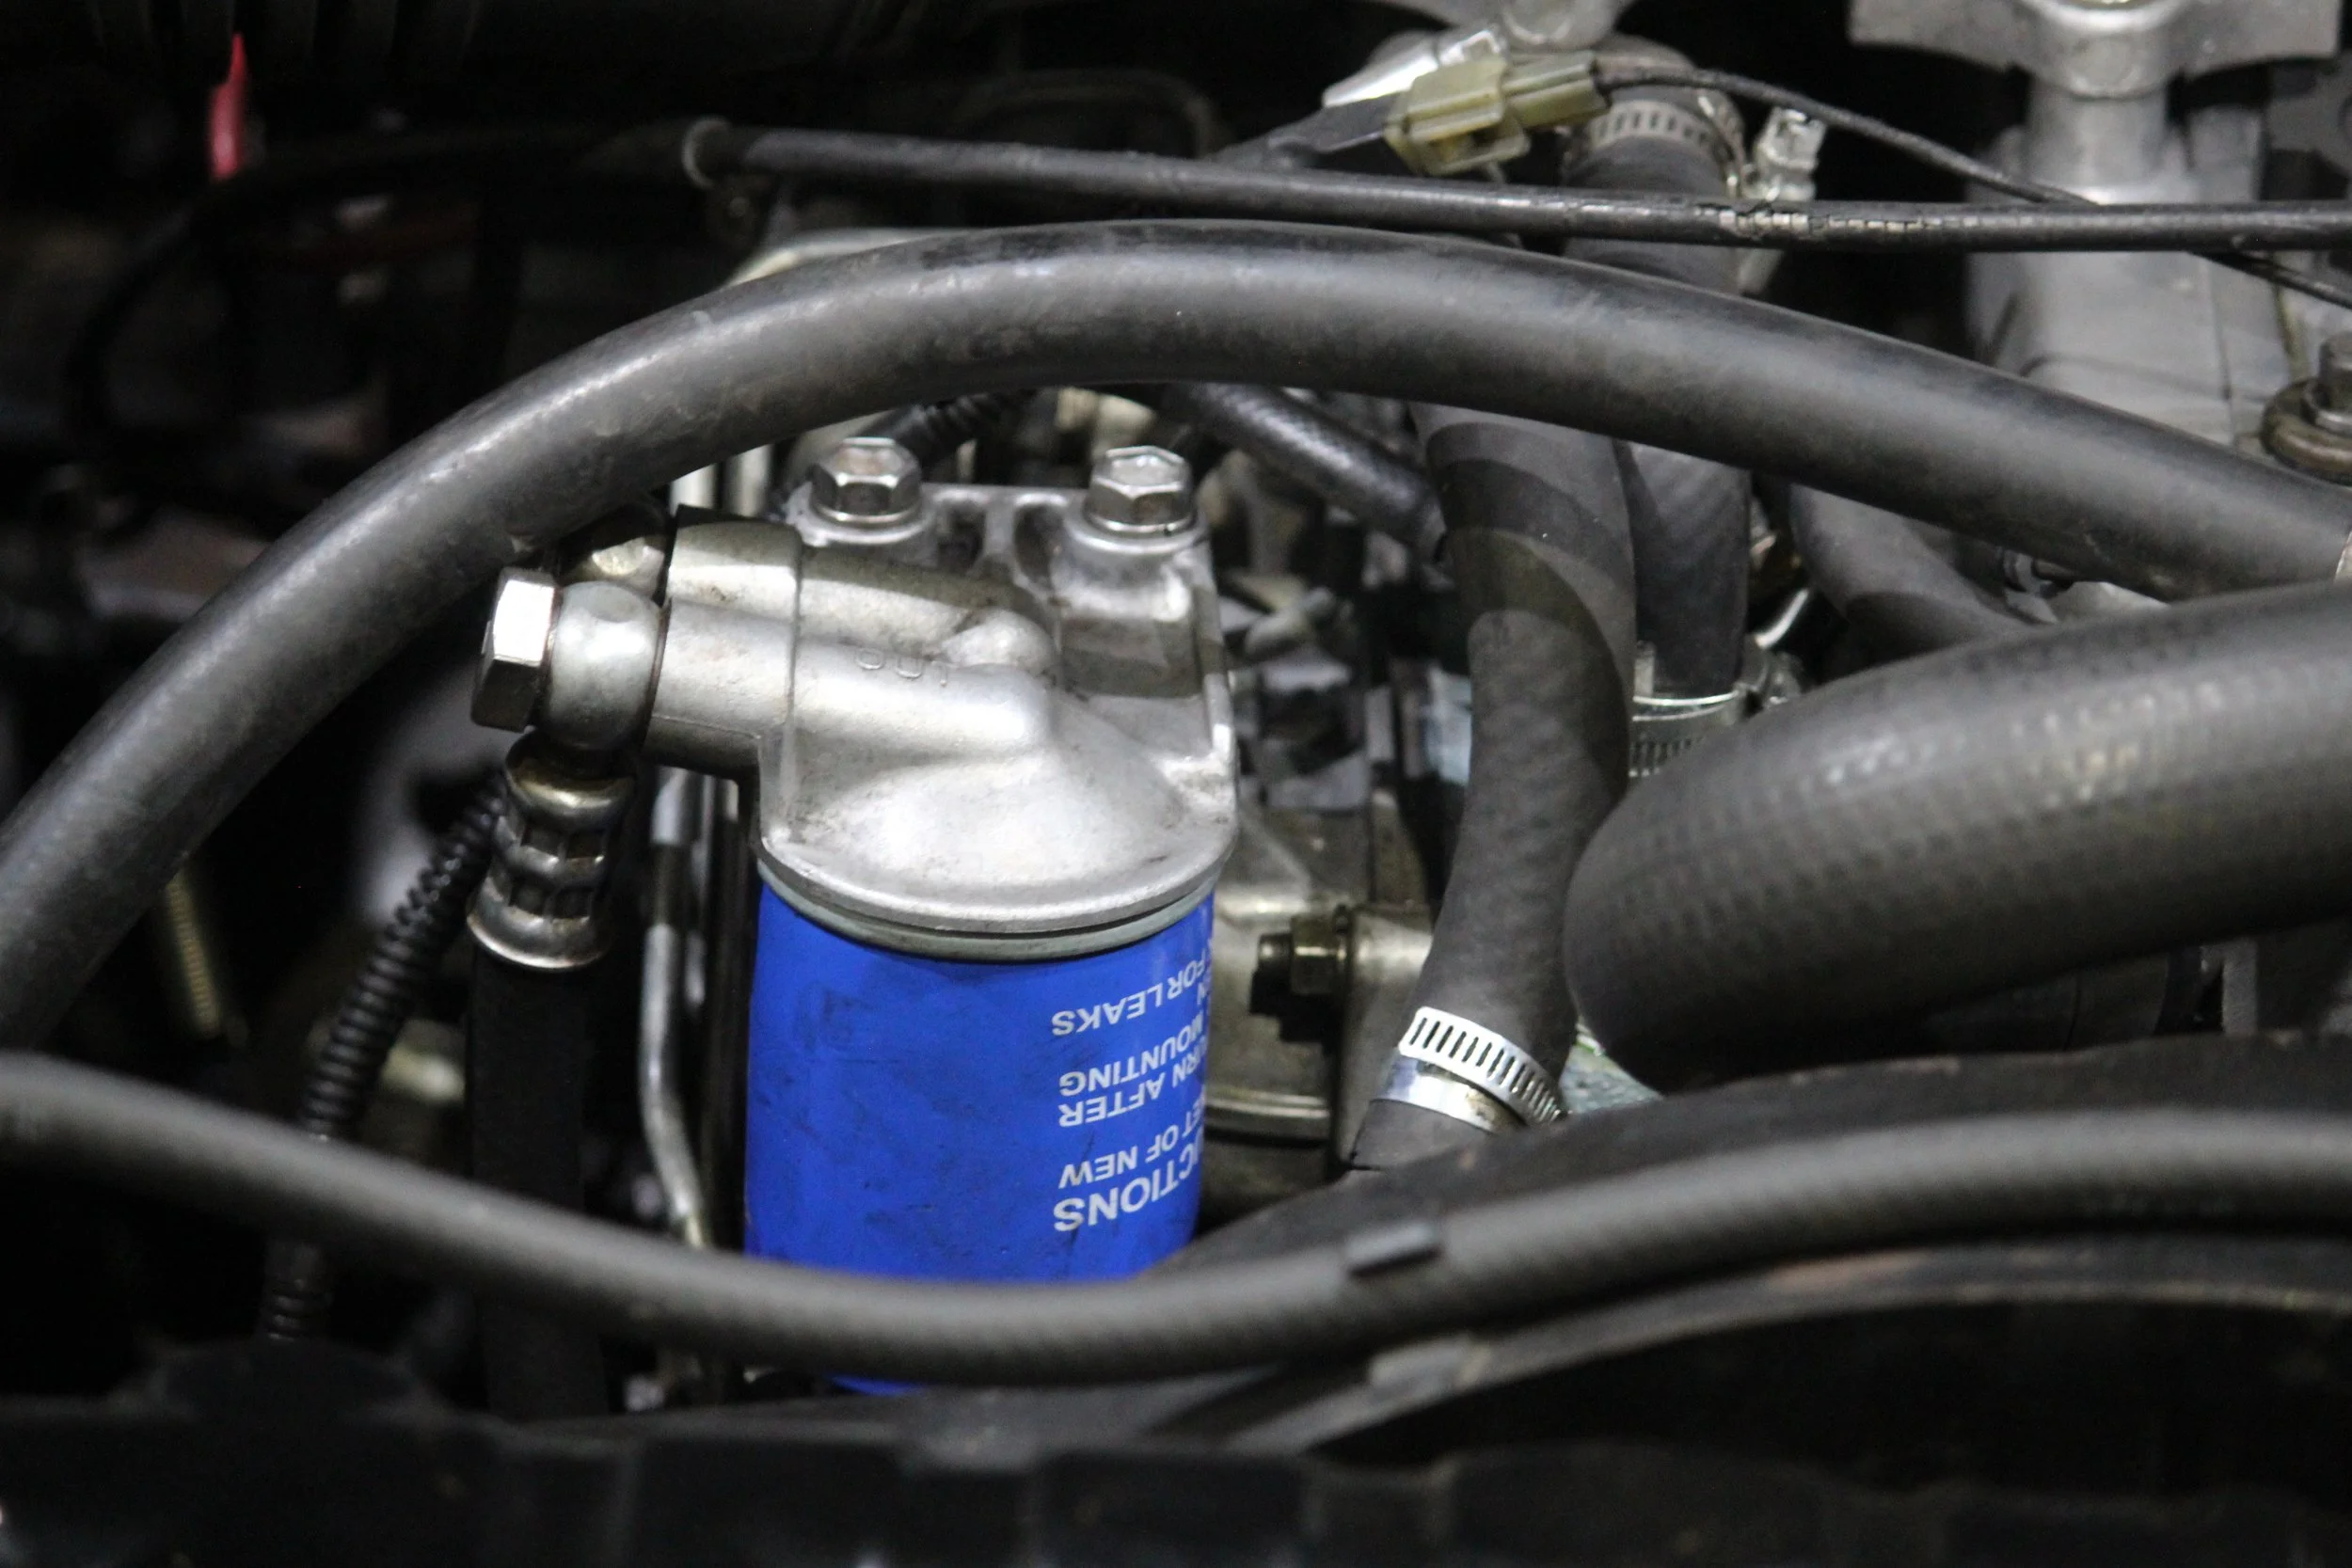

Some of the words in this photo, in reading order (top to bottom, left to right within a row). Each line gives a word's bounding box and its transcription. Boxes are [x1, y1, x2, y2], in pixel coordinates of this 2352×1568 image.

[1167, 947, 1205, 1000] FOR
[1051, 982, 1163, 1036] LEAKS
[1059, 1010, 1203, 1097] MOUNTING
[1058, 1072, 1166, 1127] AFTER
[1058, 1146, 1138, 1189] NEW
[1145, 1124, 1179, 1163] OF
